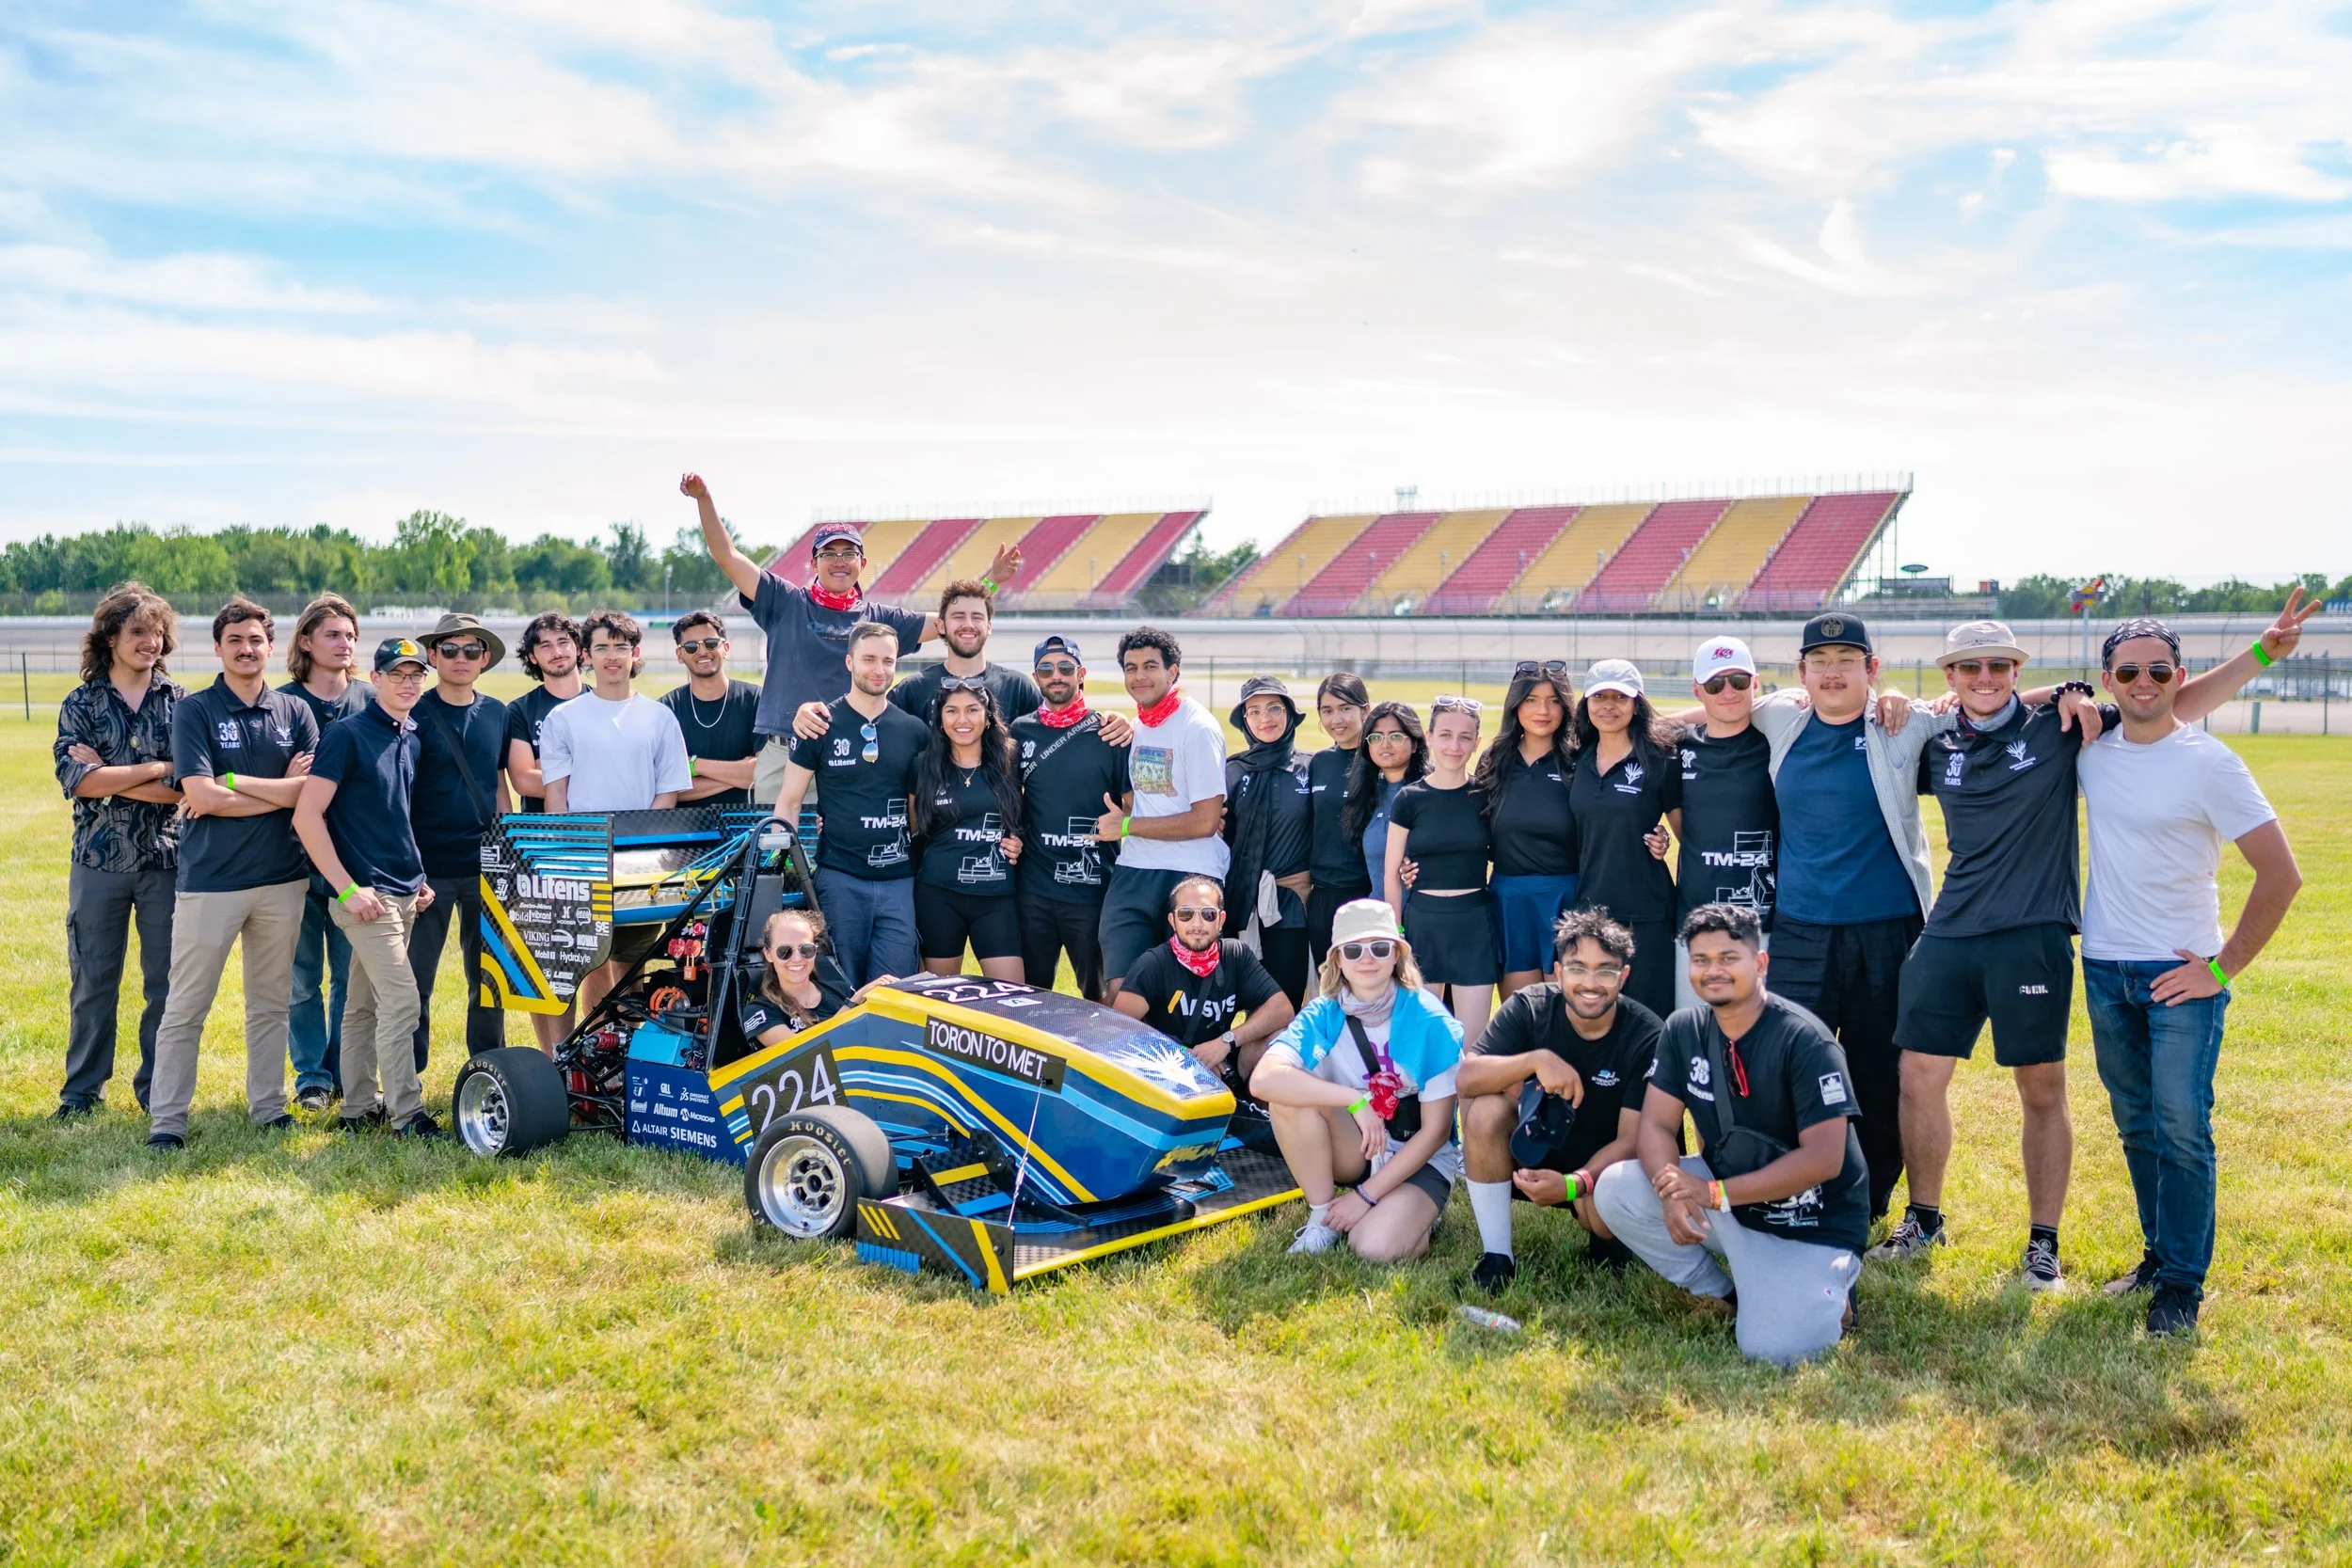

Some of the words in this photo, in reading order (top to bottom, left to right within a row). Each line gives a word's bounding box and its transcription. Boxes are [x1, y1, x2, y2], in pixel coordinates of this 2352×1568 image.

[534, 720, 543, 736] 3
[833, 738, 851, 756] 30
[1022, 740, 1036, 758] 30
[1040, 736, 1068, 760] UNDER
[1944, 777, 1962, 786] YEARS
[861, 816, 908, 829] TM-24
[955, 829, 1003, 842] TM-24
[1041, 833, 1095, 847] TM-24
[1701, 852, 1769, 866] TM-24
[532, 875, 591, 902] Litens
[523, 930, 550, 942] VIKING
[534, 949, 550, 958] Mobil
[923, 981, 1035, 1003] 224
[1007, 1045, 1047, 1081] MET
[751, 1053, 836, 1133] 224
[653, 1102, 678, 1117] Altium
[642, 1123, 668, 1136] ALTAIR
[670, 1127, 718, 1148] SIEMENS
